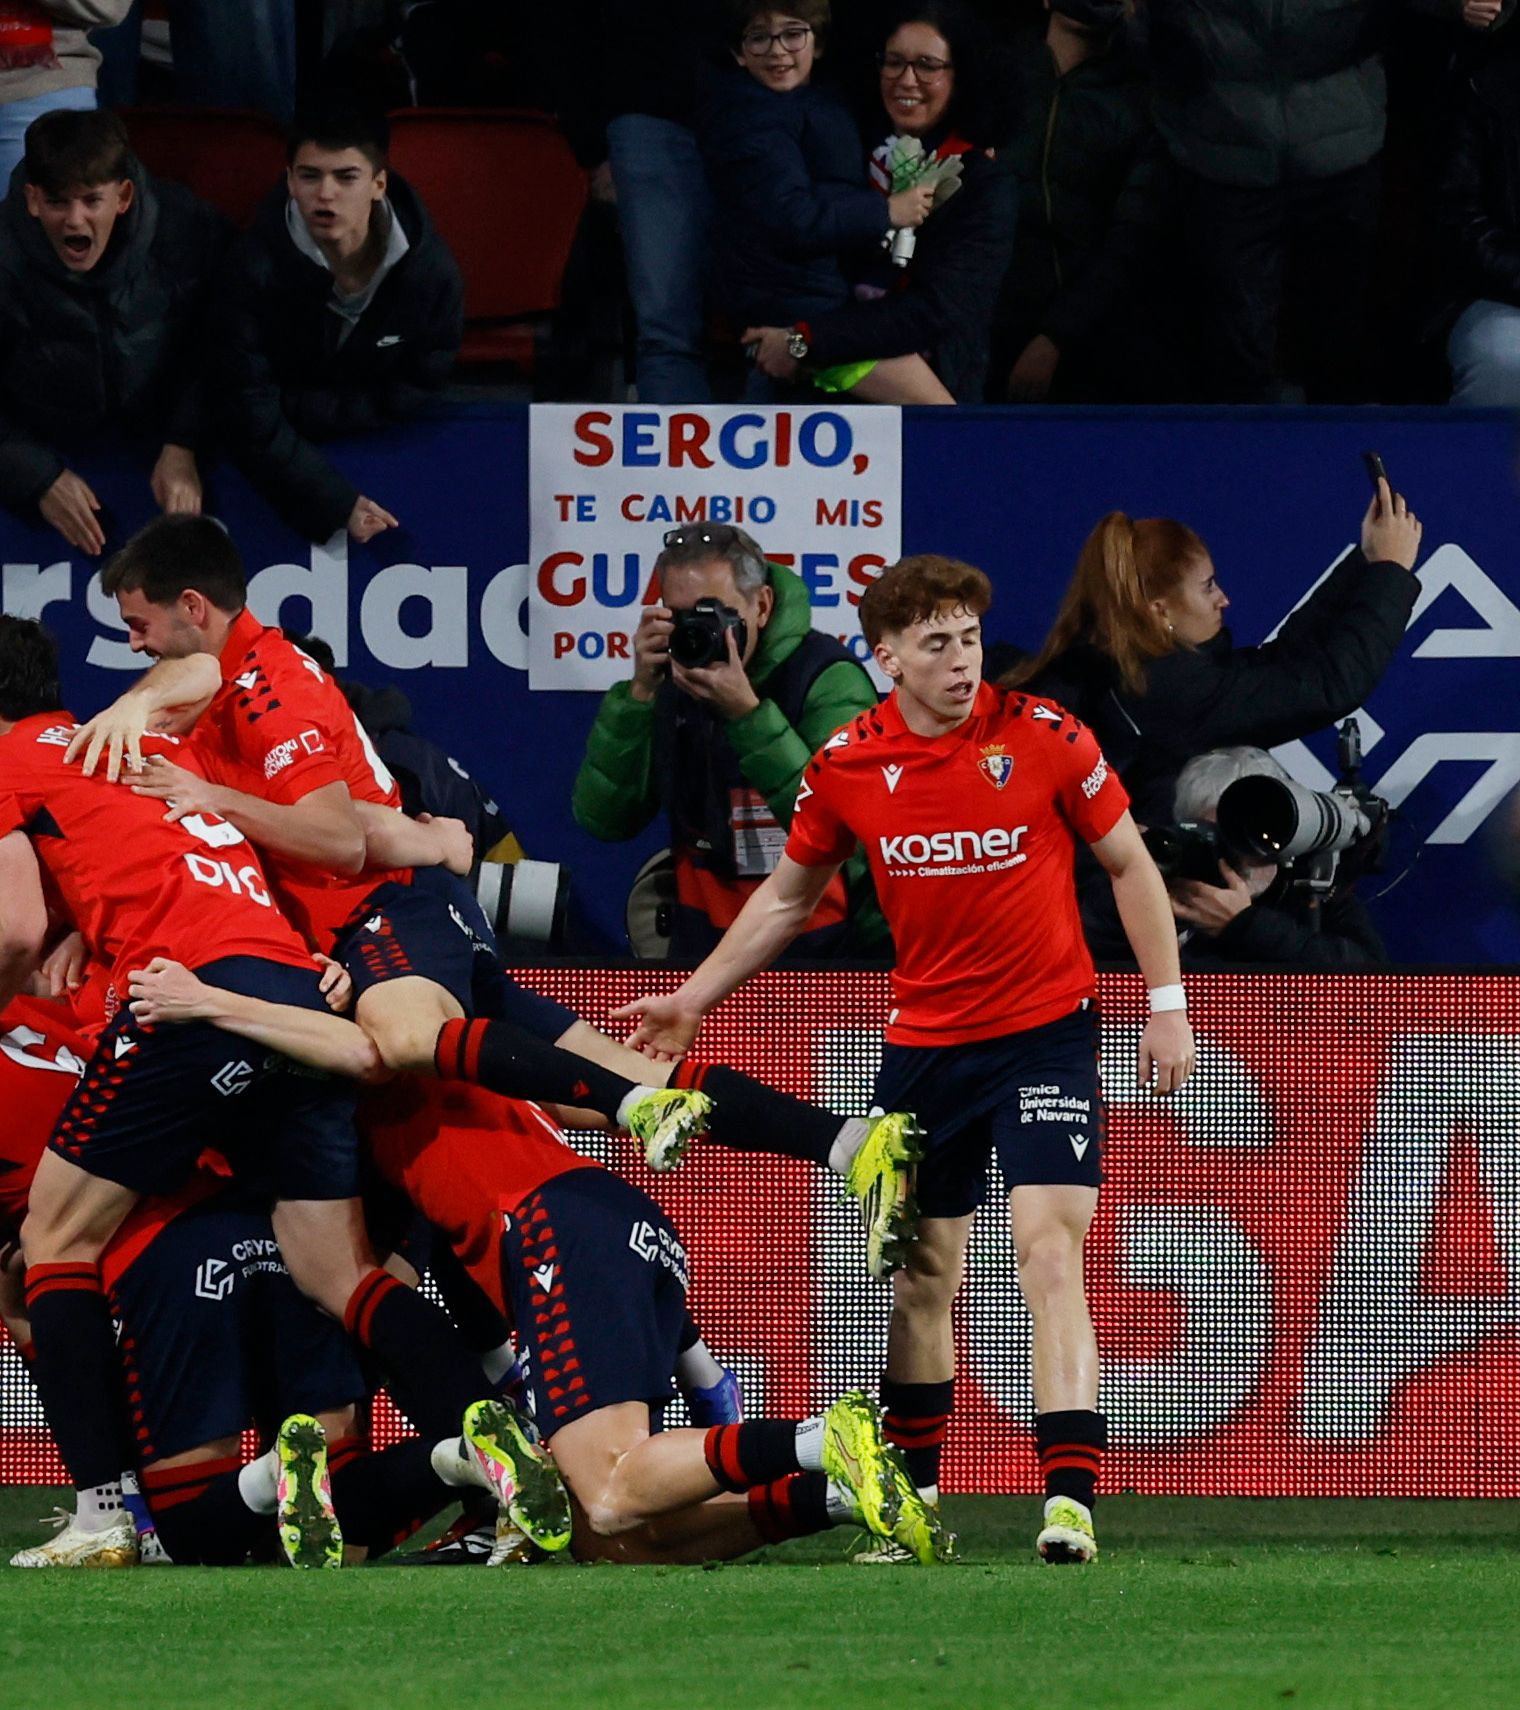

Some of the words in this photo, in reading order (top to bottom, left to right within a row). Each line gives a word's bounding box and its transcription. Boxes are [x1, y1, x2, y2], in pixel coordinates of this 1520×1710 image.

[573, 411, 869, 475] SERGIO,
[554, 495, 597, 522] TE
[620, 494, 776, 523] CAMBIO
[815, 498, 884, 528] MIS
[1020, 1096, 1090, 1112] Universidad
[1021, 1111, 1034, 1124] de
[1036, 1109, 1088, 1124] Navarra
